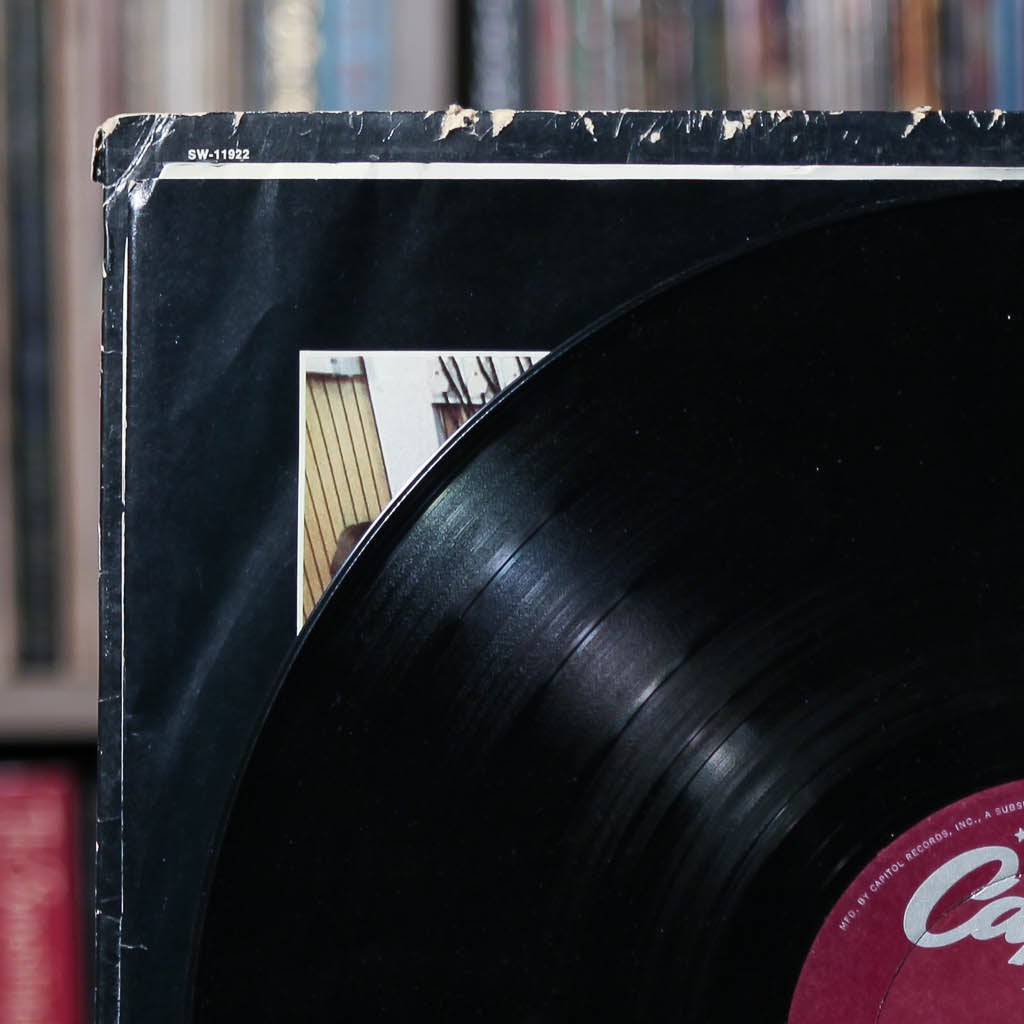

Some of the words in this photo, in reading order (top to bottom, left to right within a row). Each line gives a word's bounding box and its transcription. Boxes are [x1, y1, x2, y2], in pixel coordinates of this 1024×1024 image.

[187, 148, 250, 160] SW-11922
[838, 908, 861, 933] MFD.
[856, 891, 871, 906] BY
[869, 860, 906, 892] CAPITOL
[904, 829, 953, 862] RECORDS,
[984, 810, 993, 819] A
